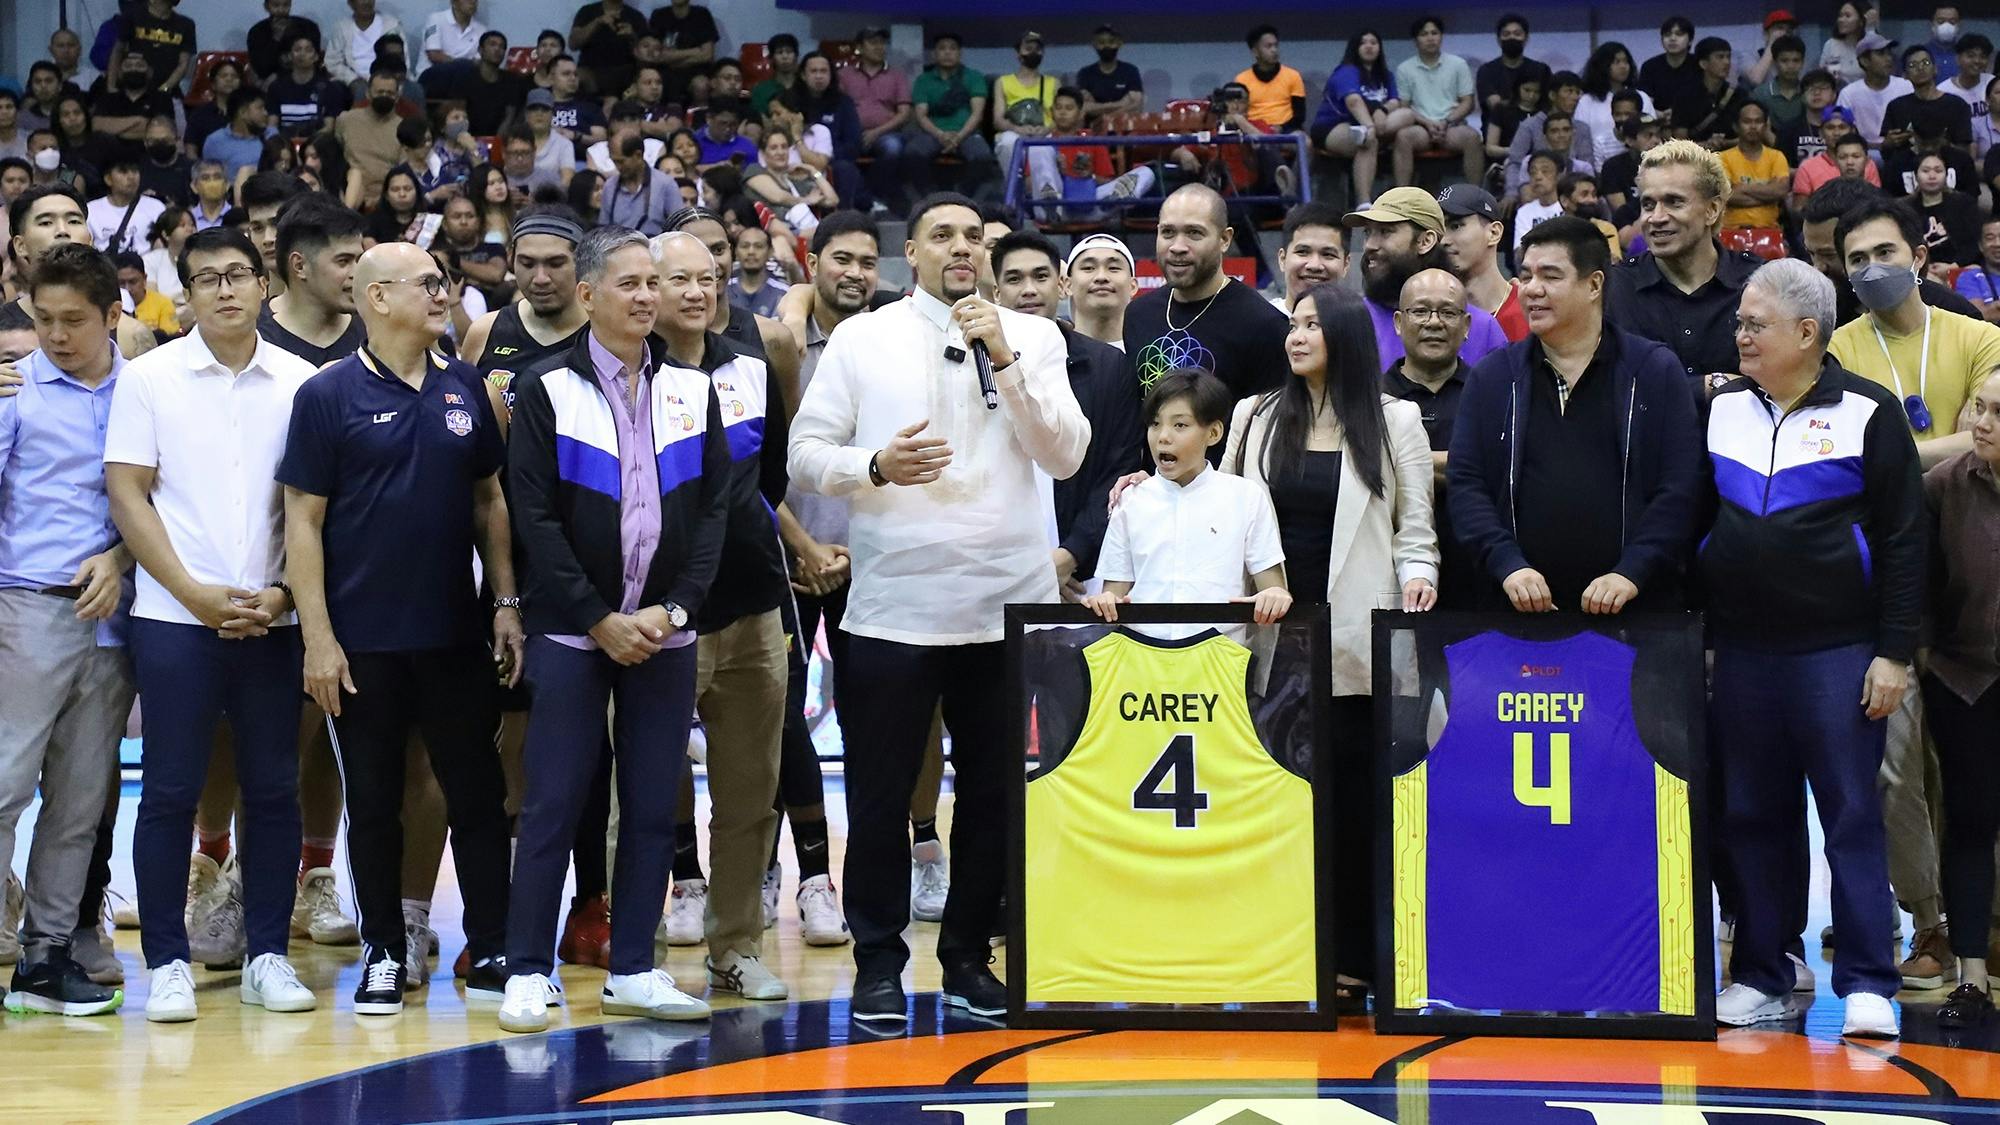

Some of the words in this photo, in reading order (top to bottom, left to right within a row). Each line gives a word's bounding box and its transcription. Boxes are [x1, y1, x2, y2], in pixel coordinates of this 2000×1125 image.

[1809, 418, 1831, 430] PBA
[1532, 666, 1561, 677] PLDT
[1119, 692, 1219, 722] CAREY
[1498, 692, 1583, 722] CAREY
[1131, 733, 1208, 829] 4
[1513, 732, 1570, 824] 4
